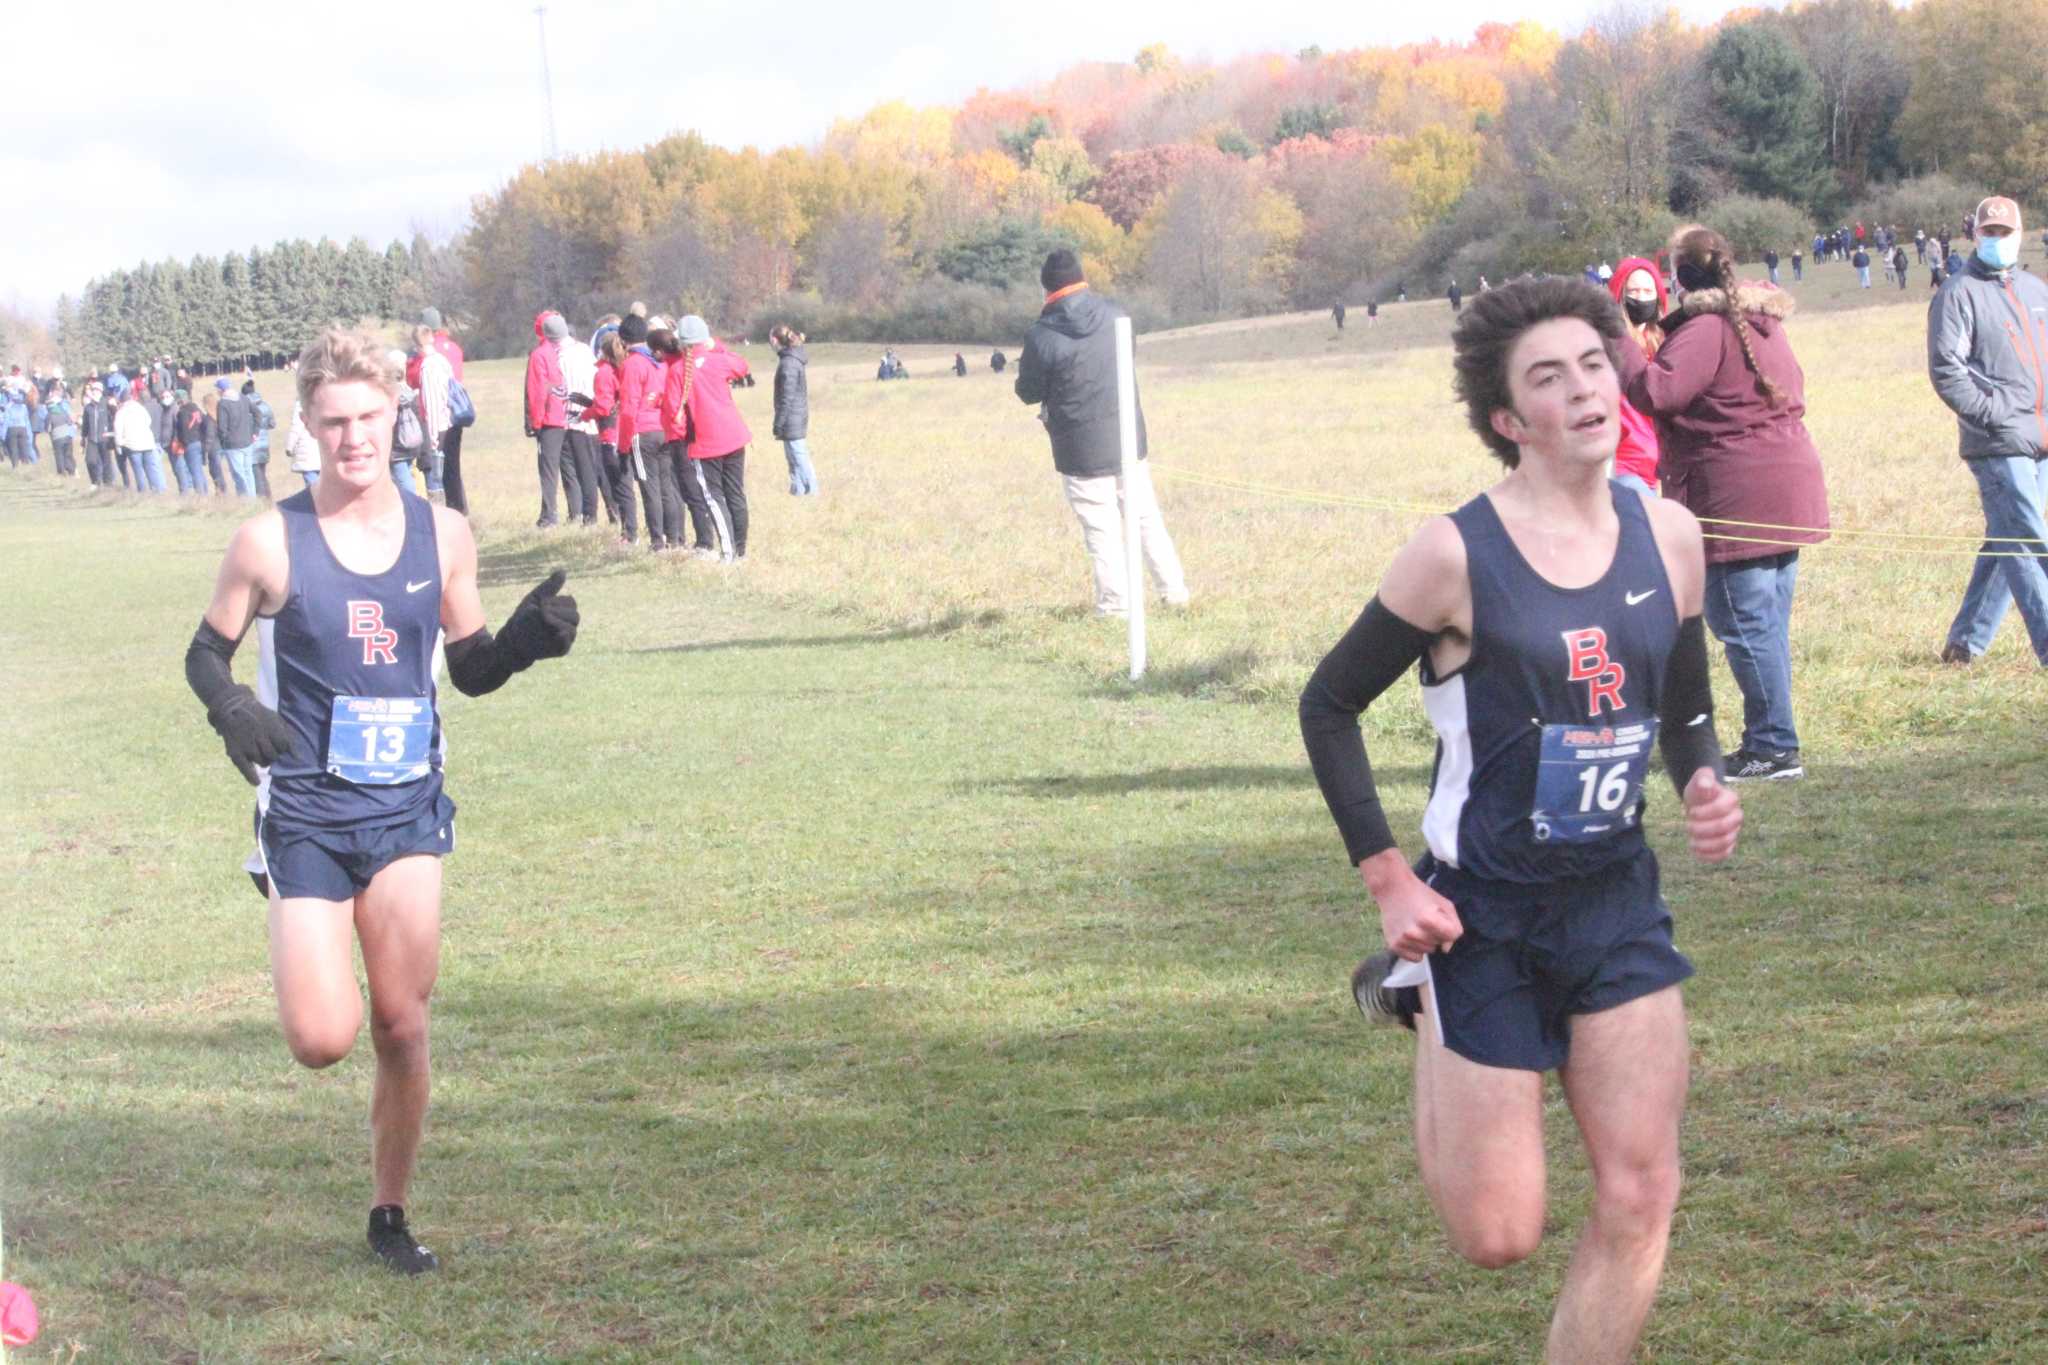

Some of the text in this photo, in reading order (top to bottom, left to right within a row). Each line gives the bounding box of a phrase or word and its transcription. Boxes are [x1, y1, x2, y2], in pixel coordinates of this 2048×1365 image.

[347, 600, 398, 665] BR
[1561, 627, 1627, 716] BR
[361, 726, 405, 762] 13
[1579, 761, 1629, 812] 16
